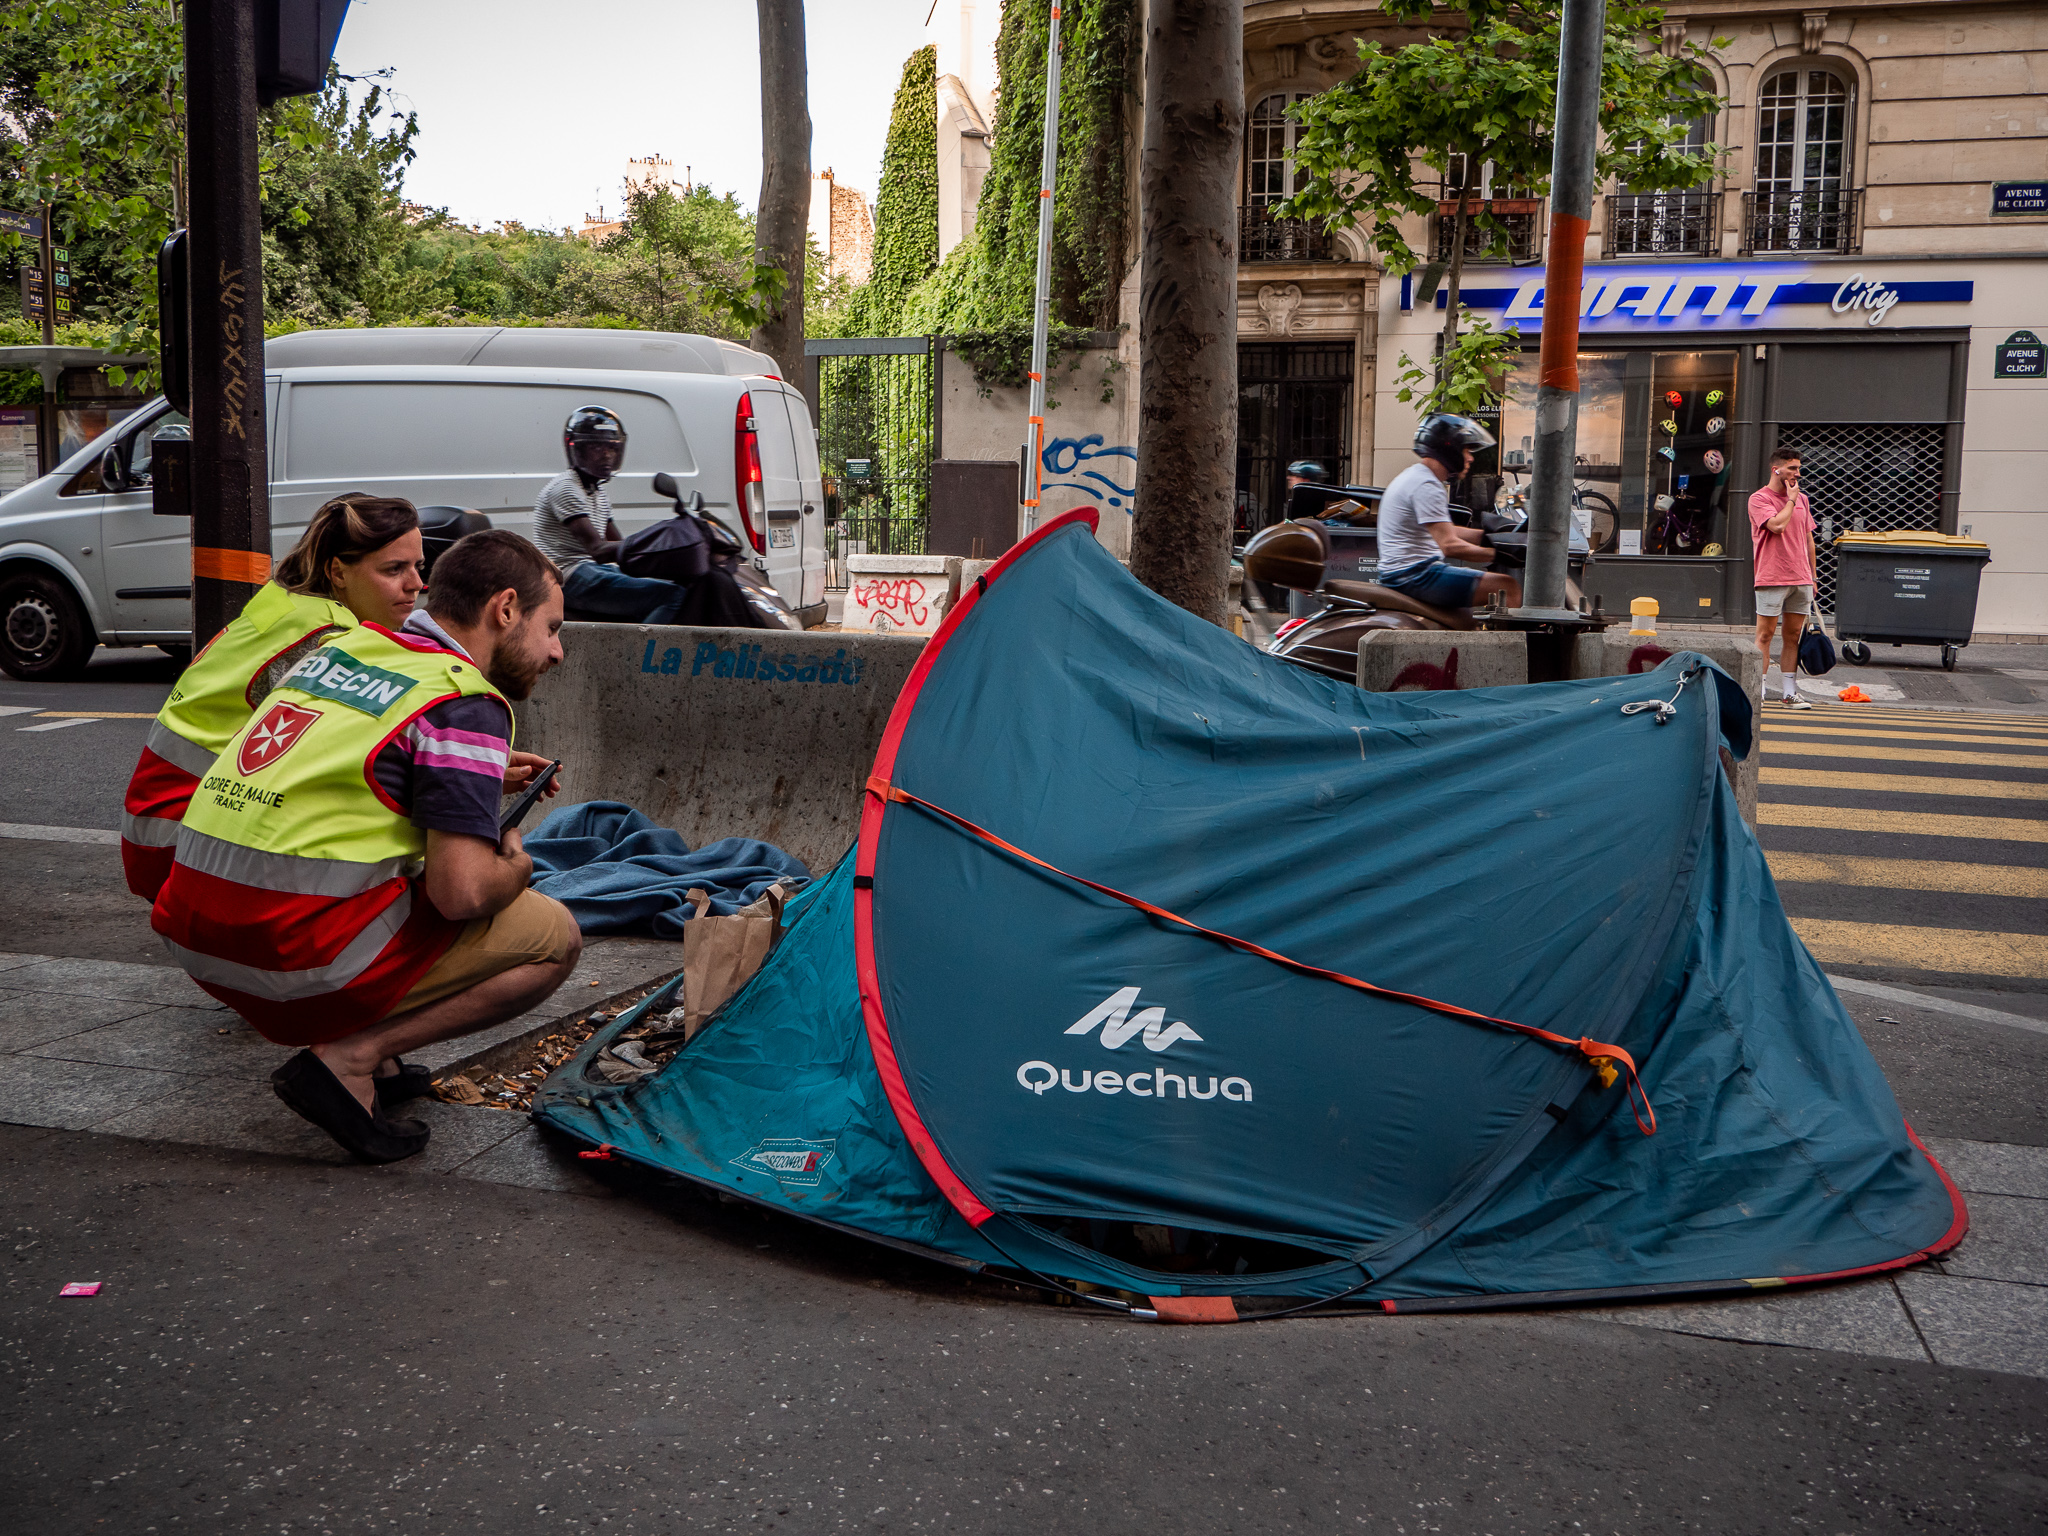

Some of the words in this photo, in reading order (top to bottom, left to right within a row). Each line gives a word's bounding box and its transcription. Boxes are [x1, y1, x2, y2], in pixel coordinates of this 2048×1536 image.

[2005, 189, 2042, 198] AVENUE
[1998, 200, 2010, 208] DE
[2012, 199, 2047, 208] CLICHY
[57, 249, 66, 260] 21
[57, 275, 67, 286] 54
[58, 299, 68, 309] 74
[1831, 272, 1899, 326] City
[2006, 350, 2039, 358] AVENUE
[2006, 364, 2037, 373] CLICHY
[641, 639, 682, 676] La
[691, 642, 864, 686] Palissade
[293, 656, 405, 706] EDECIN
[171, 687, 184, 702] ALTE
[229, 782, 246, 797] DE
[243, 786, 285, 808] MALTE
[213, 794, 246, 812] FRANCE
[1016, 1060, 1253, 1102] Quechua
